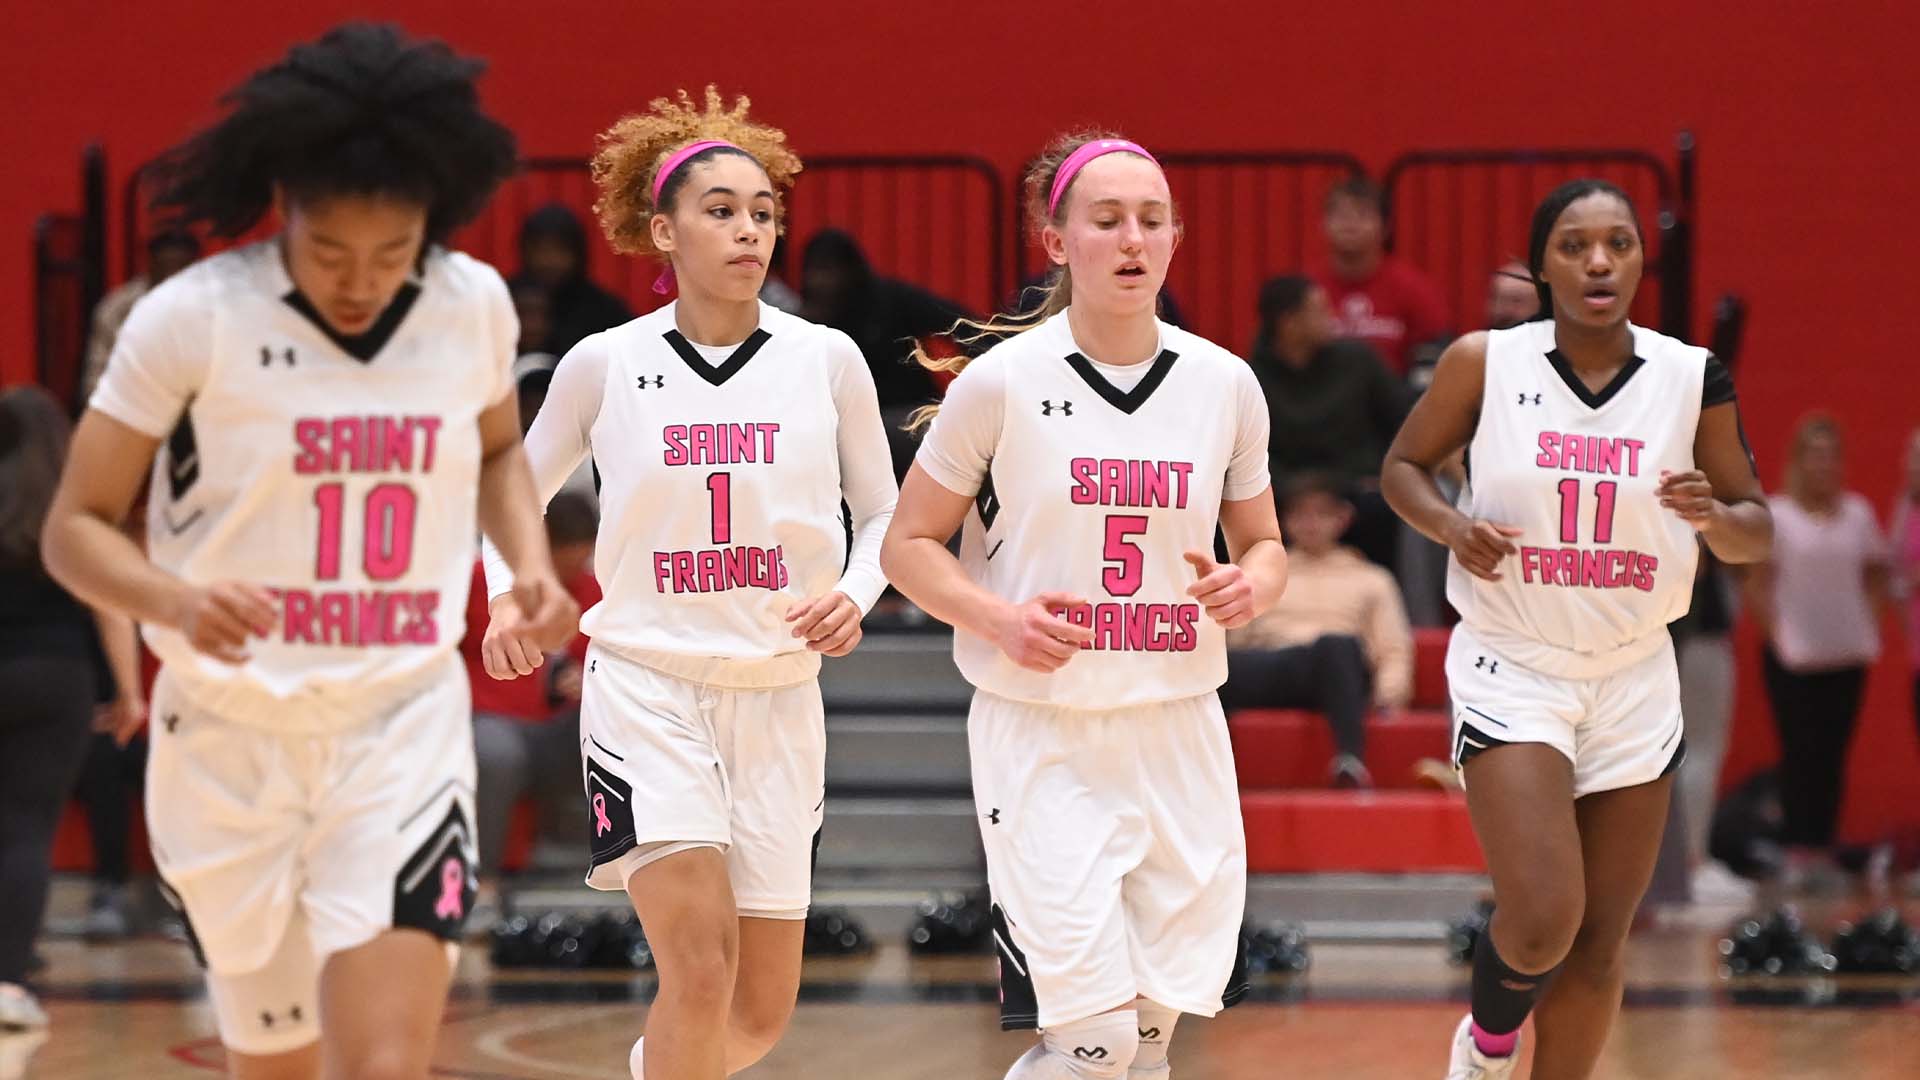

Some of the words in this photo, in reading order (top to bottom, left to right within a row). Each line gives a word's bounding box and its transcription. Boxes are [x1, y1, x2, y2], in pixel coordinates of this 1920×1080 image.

[295, 415, 443, 474] SAINT
[663, 422, 780, 466] SAINT
[1536, 431, 1646, 477] SAINT
[707, 472, 731, 545] 1
[1071, 457, 1194, 509] SAINT
[1558, 478, 1617, 544] 11
[313, 481, 419, 581] 10
[1102, 514, 1149, 597] 5
[1521, 546, 1659, 592] FRANCIS
[264, 586, 441, 646] RANCS
[1050, 602, 1199, 652] RANCIS
